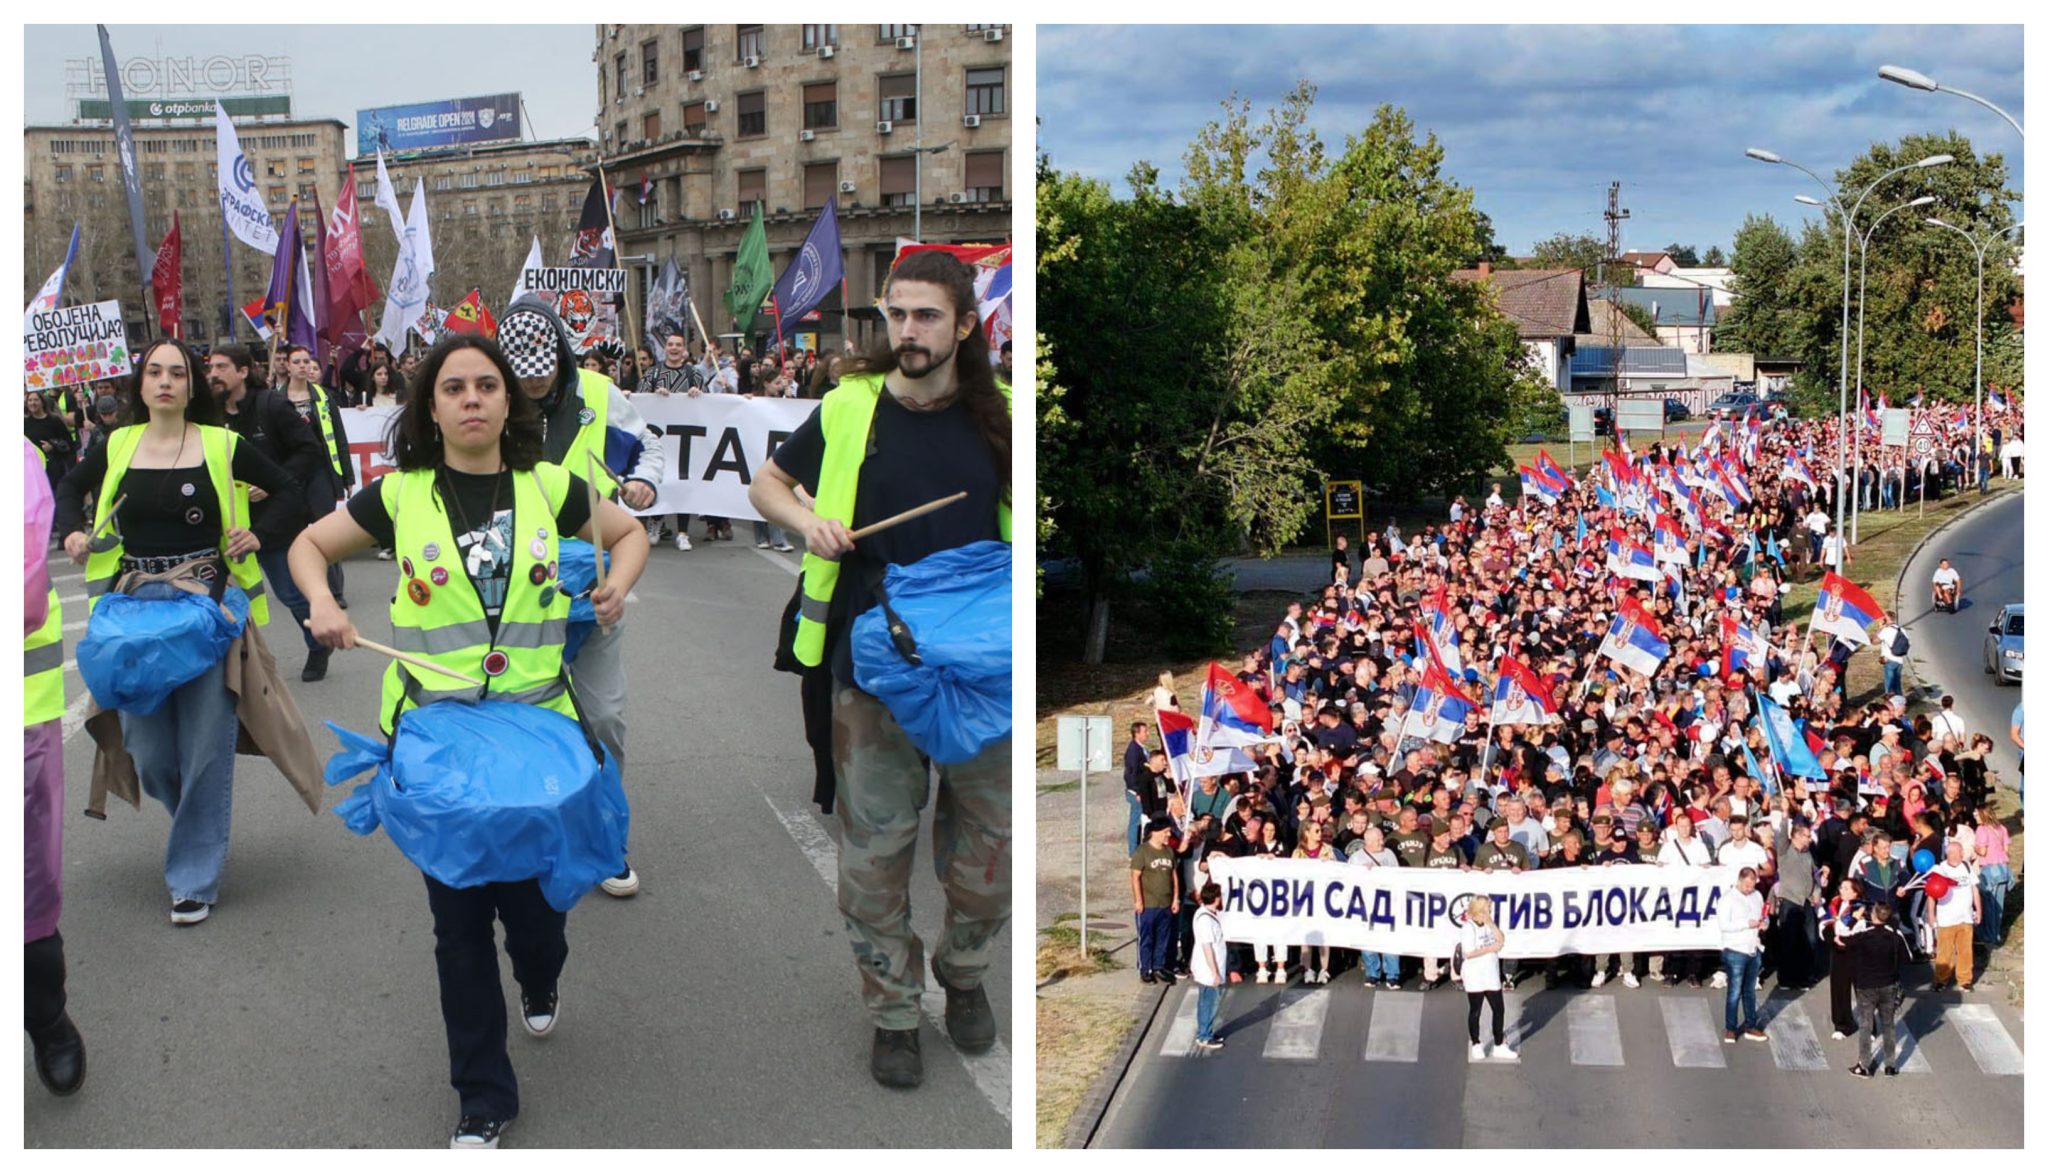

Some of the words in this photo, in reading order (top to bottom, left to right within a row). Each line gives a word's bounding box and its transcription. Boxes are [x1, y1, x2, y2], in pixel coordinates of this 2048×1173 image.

[87, 54, 272, 93] HONOR
[165, 101, 216, 116] otpbanka
[397, 114, 438, 132] BELGRADE
[439, 111, 460, 128] OPEN
[460, 110, 475, 126] 2024
[525, 268, 626, 291] ЕКОНОМСКИ
[32, 304, 102, 332] ОБОЈЕНА
[646, 423, 794, 485] ТА
[1224, 875, 1314, 917] НОВИ
[1324, 881, 1396, 932] САД
[1562, 885, 1722, 929] БЛОКАДА
